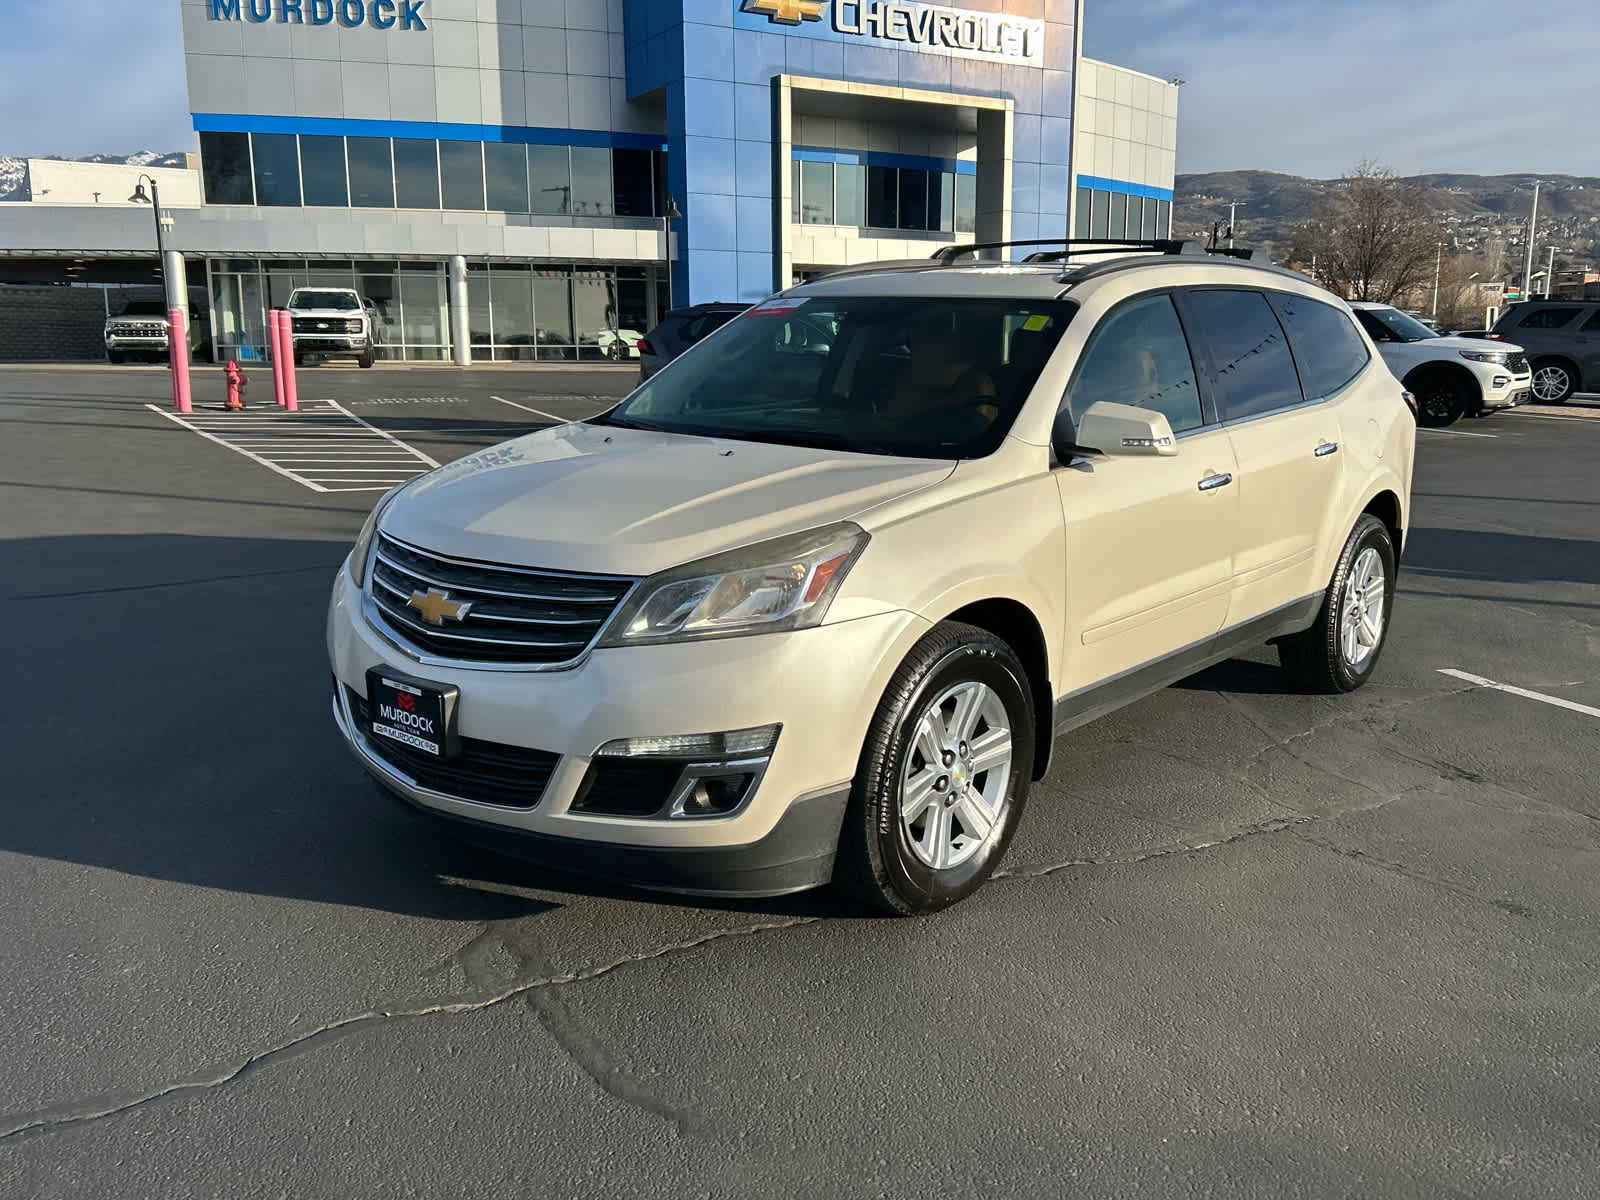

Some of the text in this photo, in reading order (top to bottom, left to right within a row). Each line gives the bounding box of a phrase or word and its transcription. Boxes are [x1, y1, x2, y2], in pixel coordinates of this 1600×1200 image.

[208, 0, 428, 31] MURDOCK
[831, 0, 1039, 57] CHEVROLET
[380, 703, 434, 734] MURDOCK
